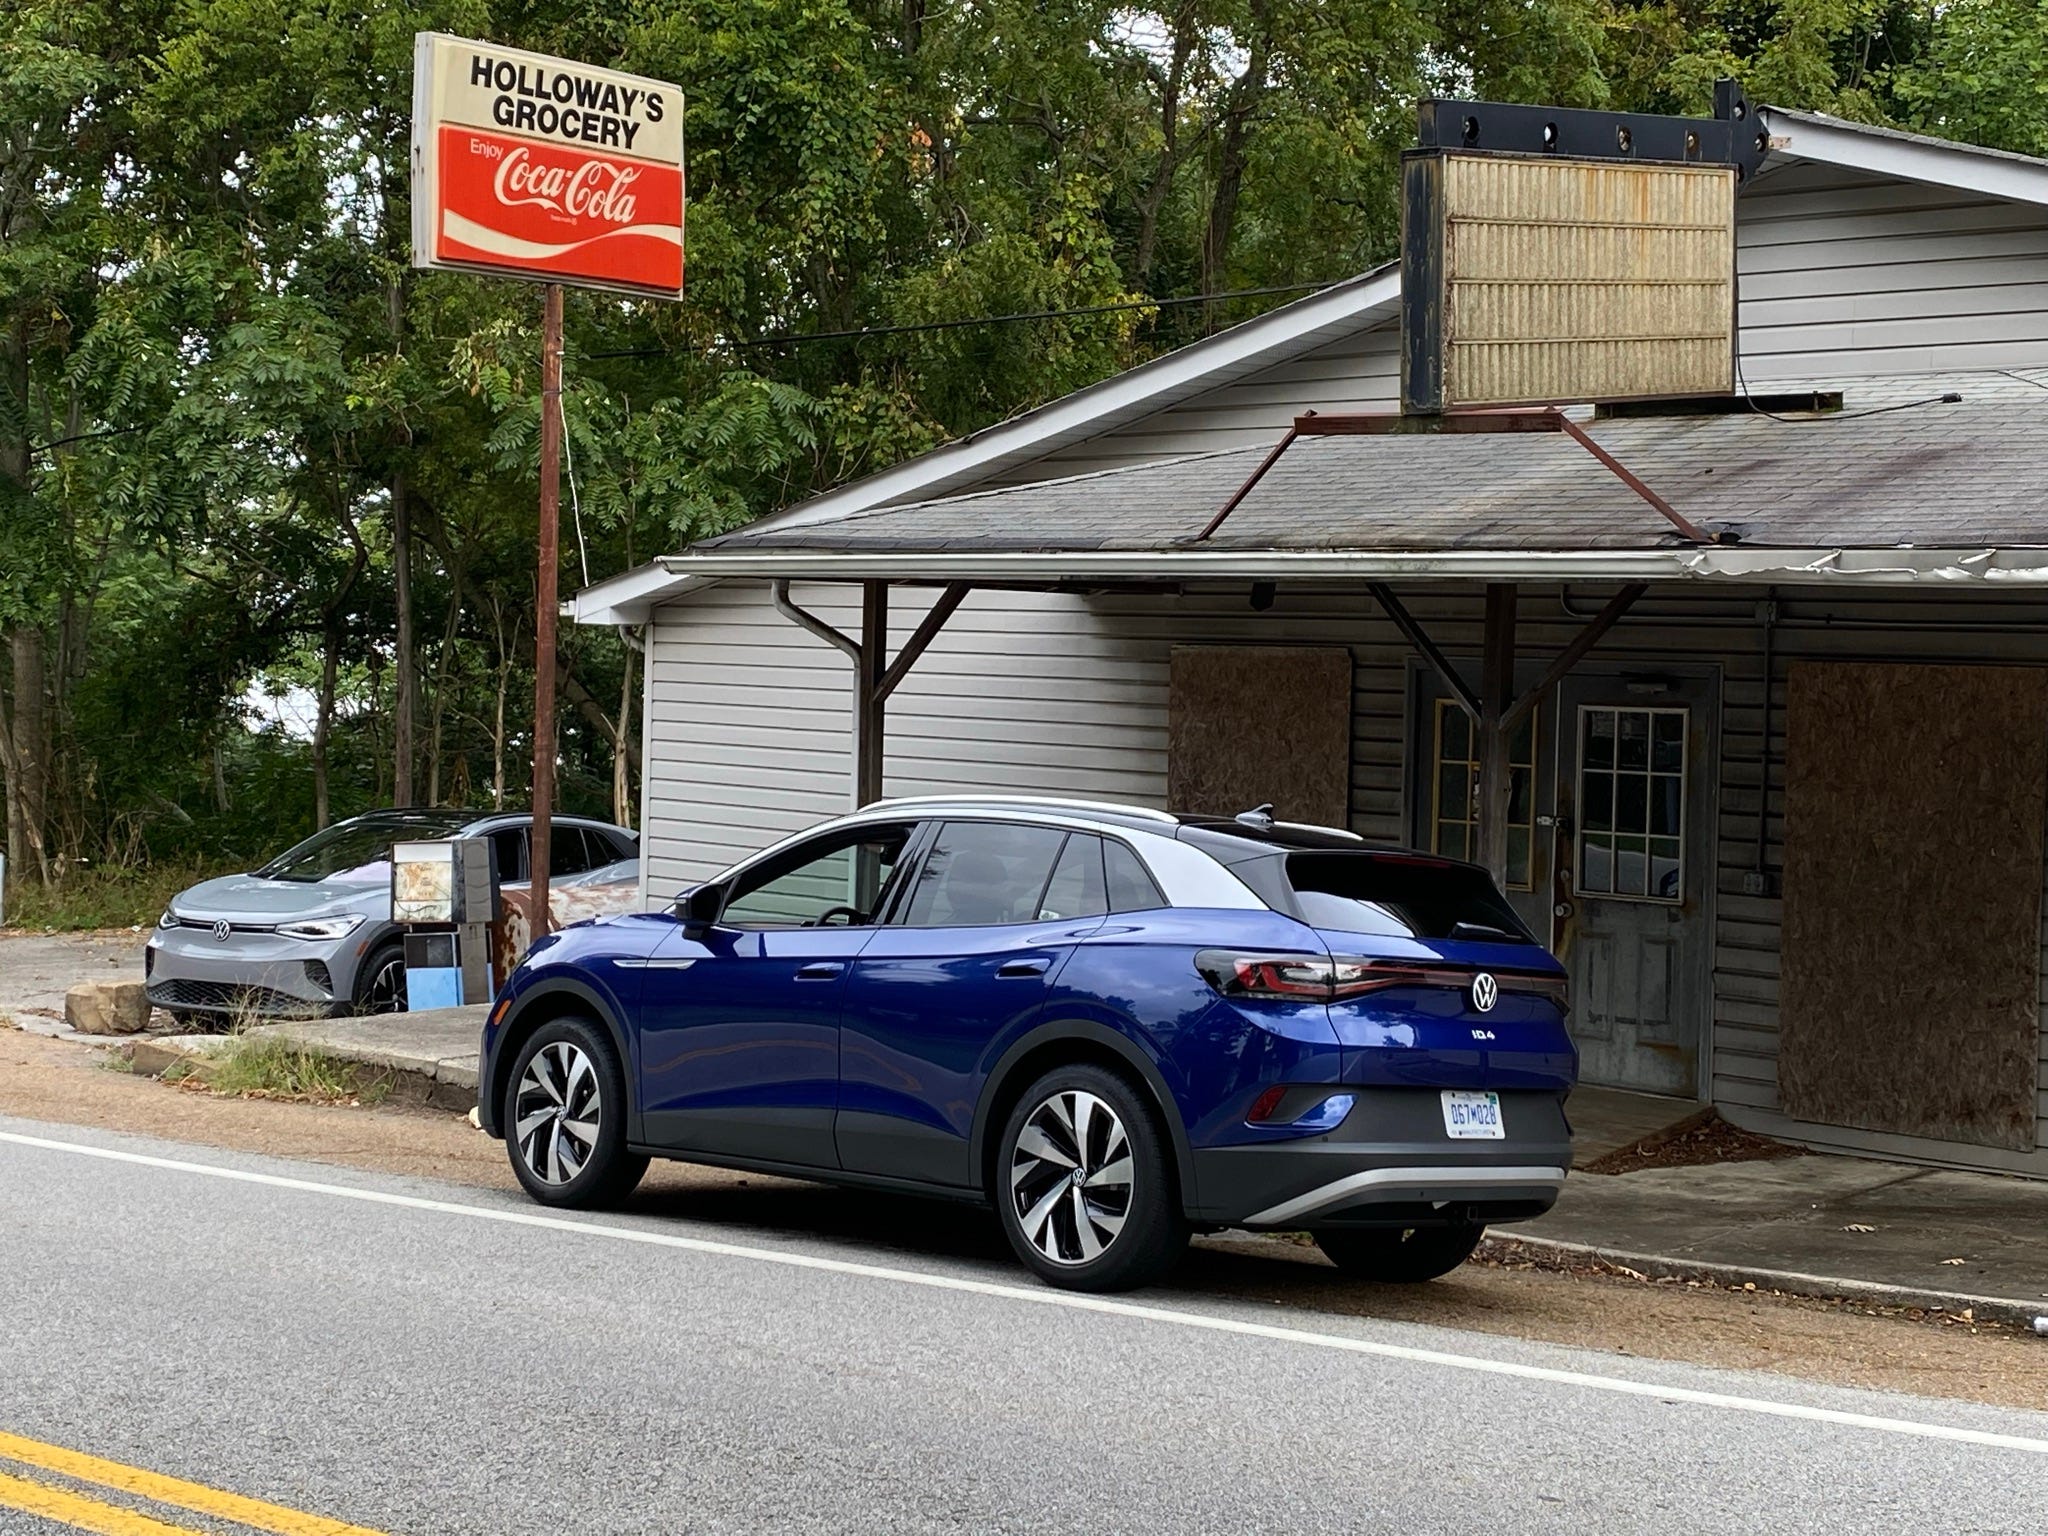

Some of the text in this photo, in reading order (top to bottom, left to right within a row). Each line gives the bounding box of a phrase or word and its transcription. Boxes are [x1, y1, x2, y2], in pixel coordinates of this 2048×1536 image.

[470, 55, 664, 122] HOLLOWAY'S
[470, 138, 504, 161] Enjoy
[493, 95, 640, 150] GROCERY
[494, 147, 643, 223] Coca-Cola
[1473, 973, 1497, 1012] VW
